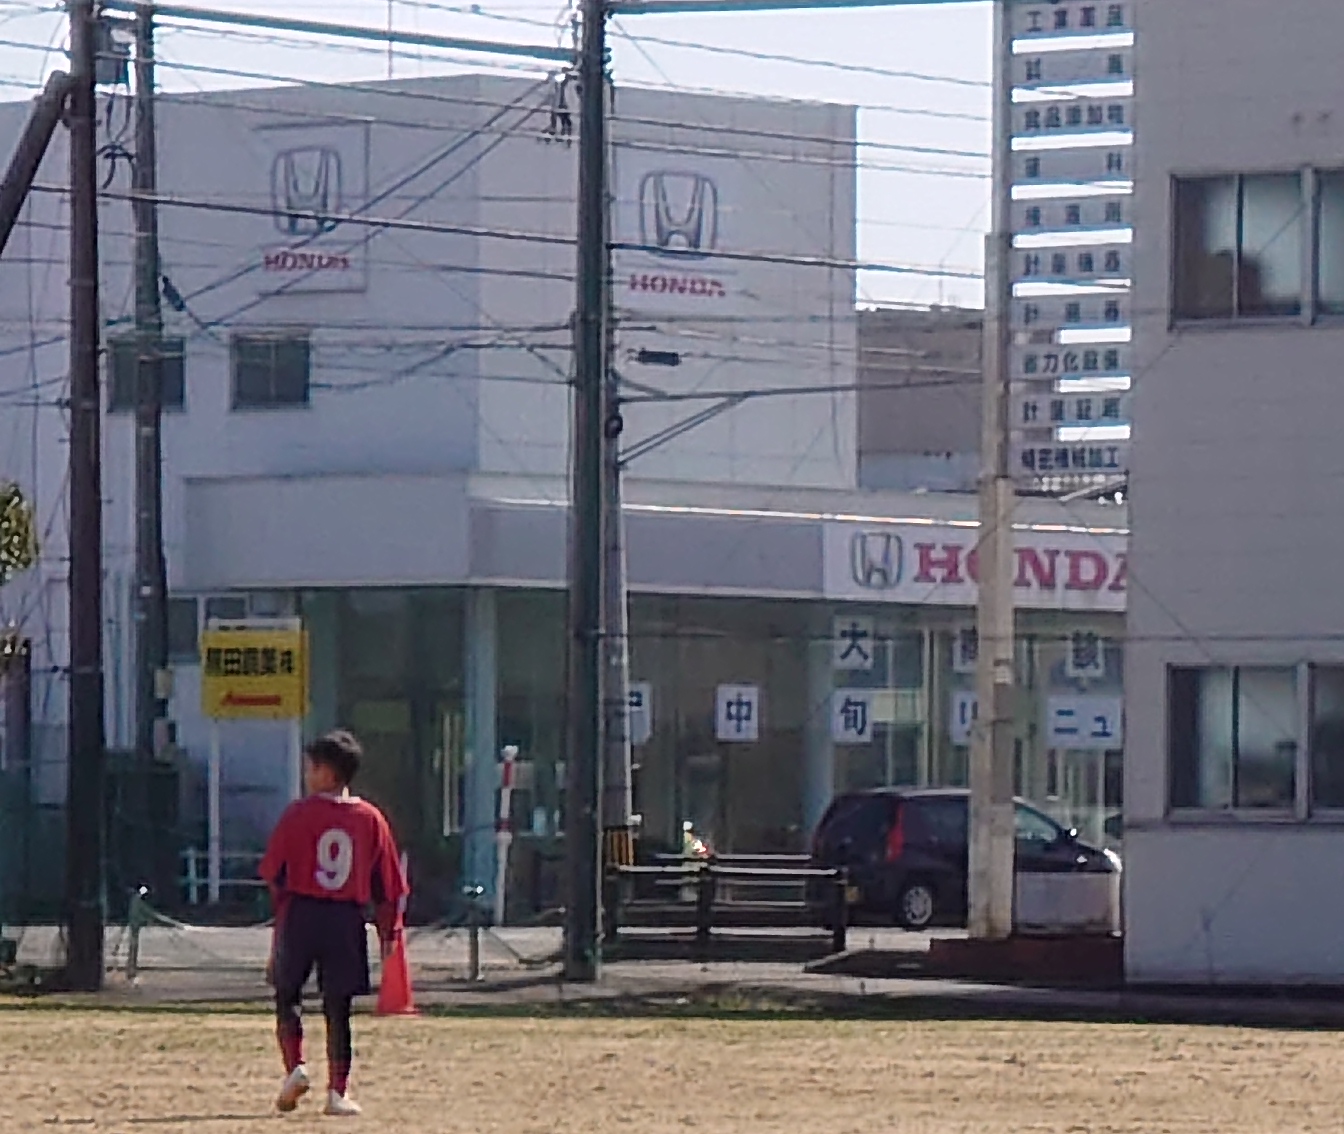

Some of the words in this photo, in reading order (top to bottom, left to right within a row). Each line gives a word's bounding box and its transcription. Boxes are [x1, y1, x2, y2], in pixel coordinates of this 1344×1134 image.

[630, 274, 726, 297] HONDA
[840, 622, 869, 660] 大
[726, 692, 752, 733] 中
[315, 828, 353, 890] 9
